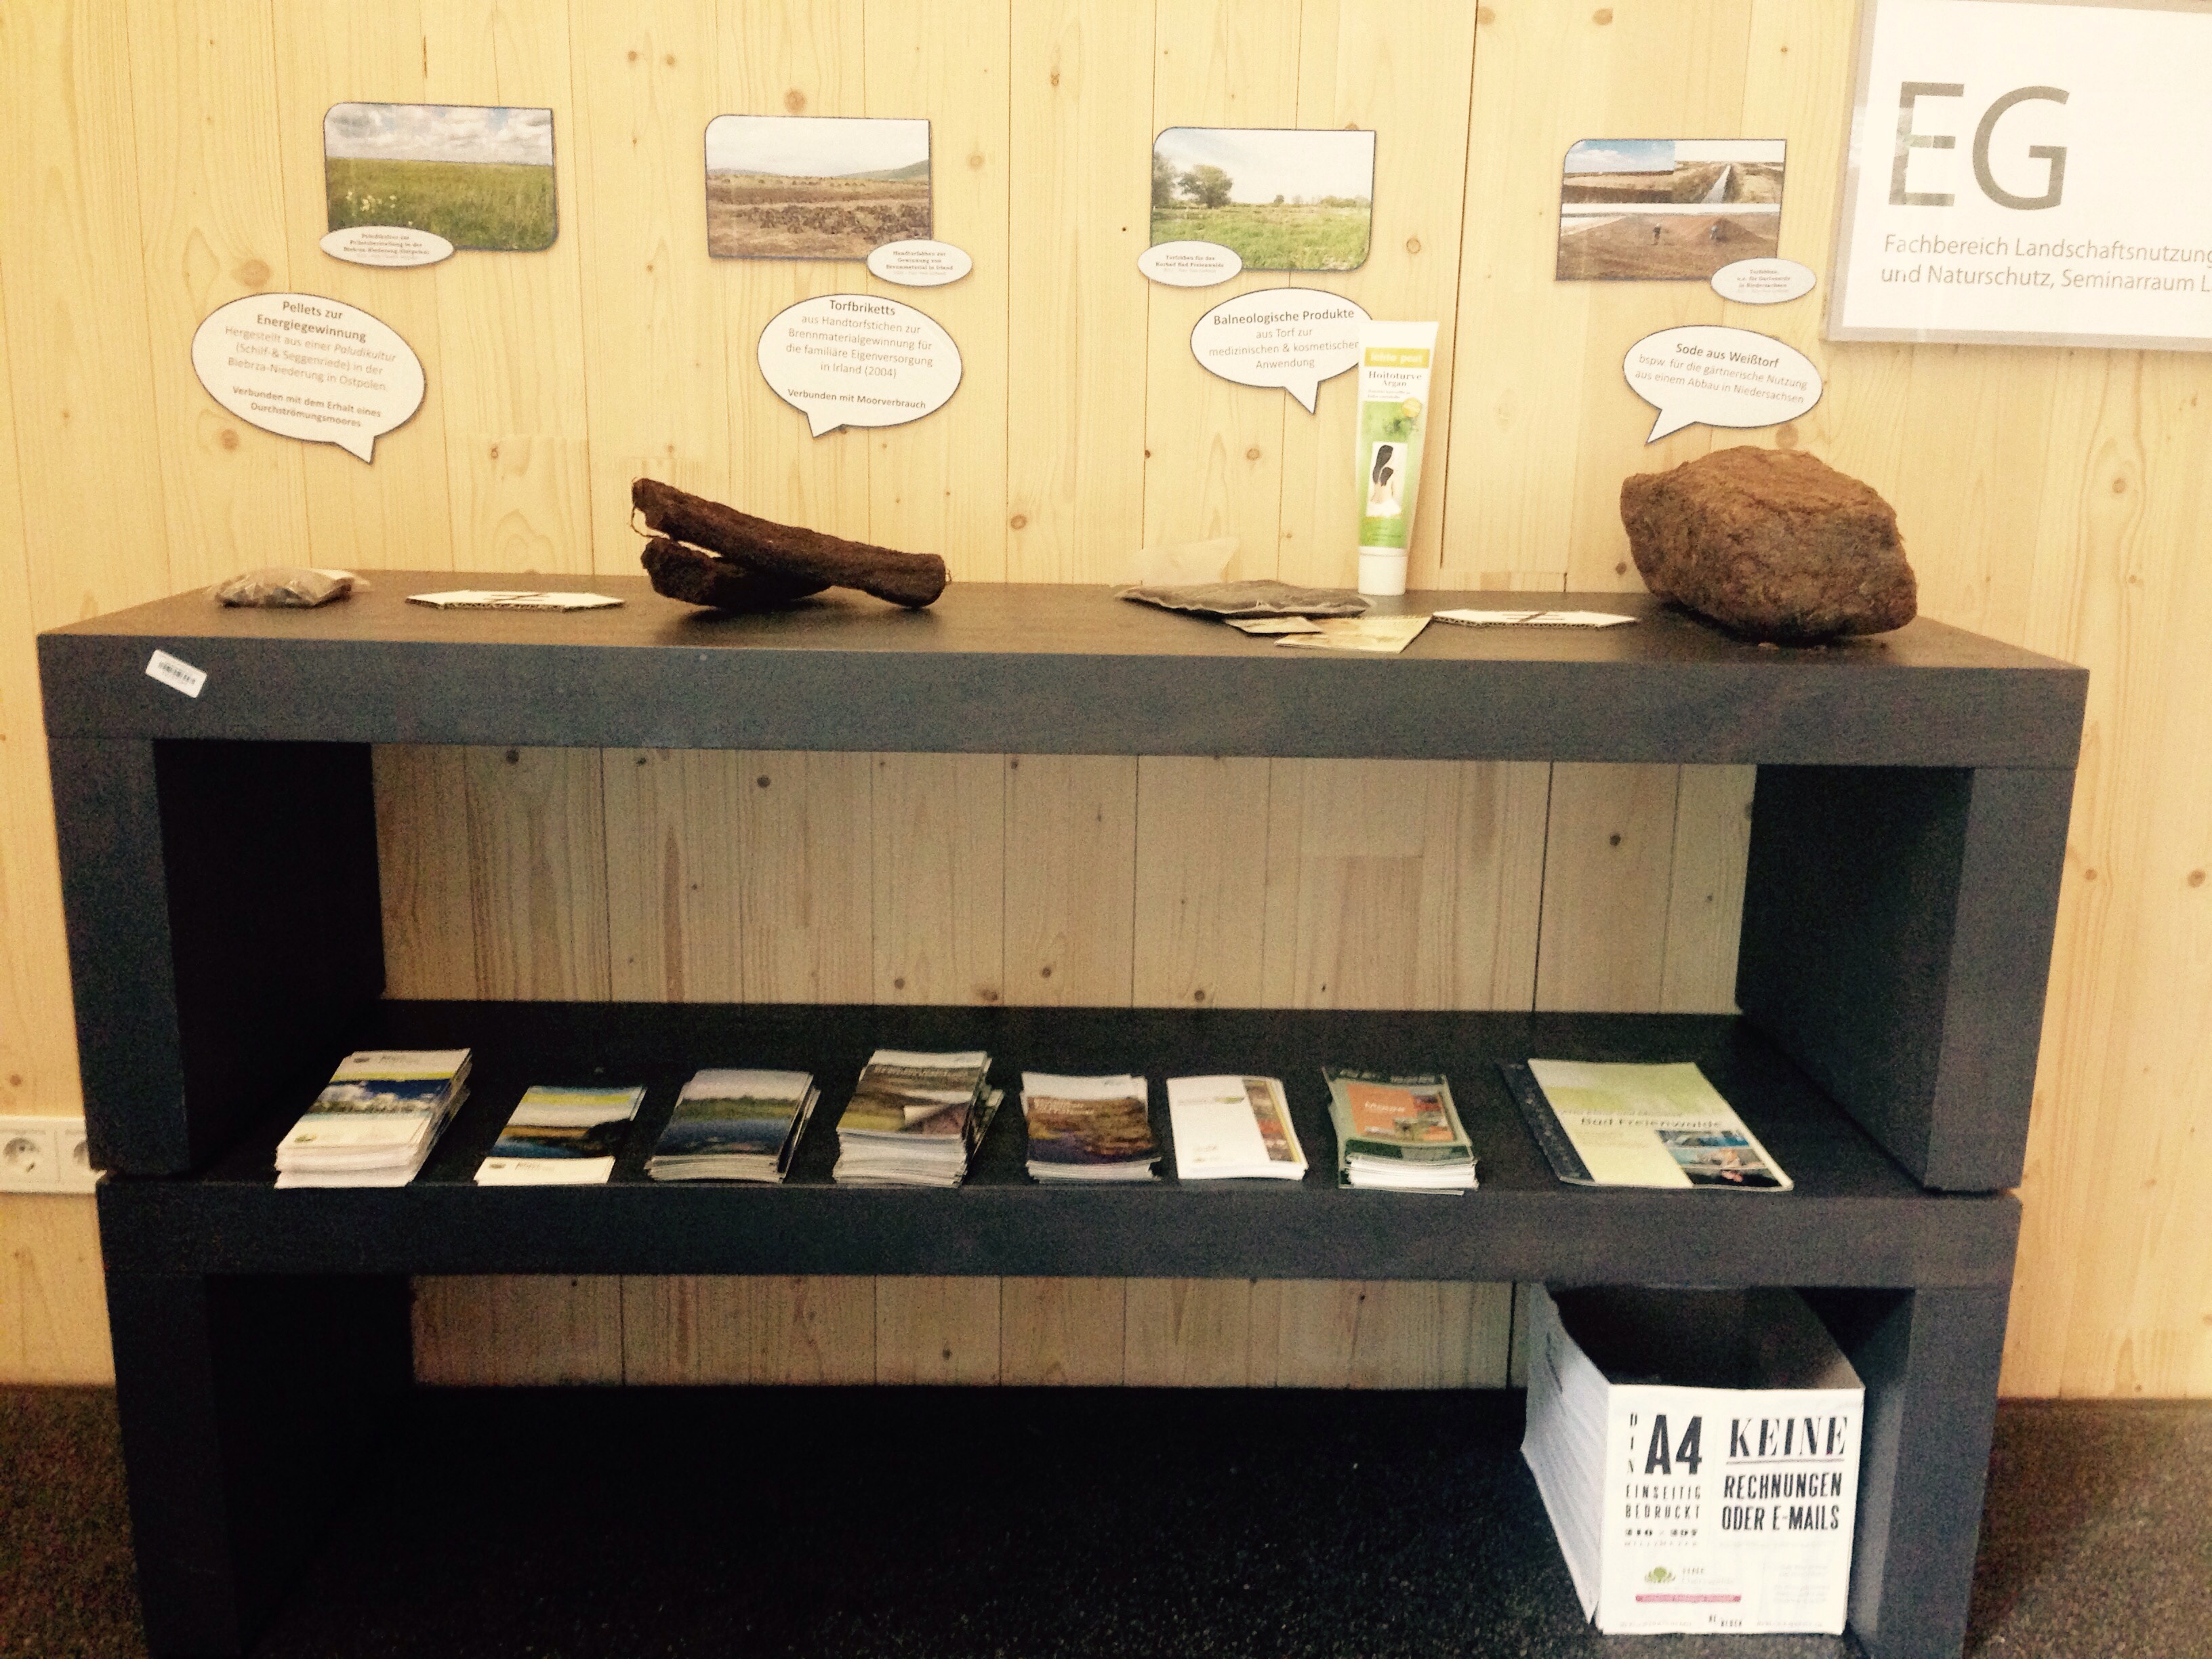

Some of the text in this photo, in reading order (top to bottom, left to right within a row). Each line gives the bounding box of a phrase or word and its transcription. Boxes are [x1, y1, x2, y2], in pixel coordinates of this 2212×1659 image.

[1889, 81, 2070, 210] EG
[1885, 234, 2008, 256] Fachbereich
[1881, 265, 1921, 283] und
[1928, 265, 2055, 289] Naturschutz,
[2062, 270, 2194, 292] Seminarraum
[283, 301, 342, 319] Pellets zur
[830, 300, 895, 316] Torfbriketts
[1214, 308, 1354, 325] Balneologische Produkte
[258, 314, 366, 344] Energiegewinnung
[802, 315, 921, 333] aus Handtorfstichen zur
[1256, 328, 1312, 338] aus Torf zur
[226, 326, 396, 363] Hergestellt aus einer Paludikultur
[789, 328, 932, 350] Brennmaterialgewinnung für
[1209, 344, 1279, 356] medizinischen
[1283, 344, 1289, 352] &
[272, 348, 279, 358] &
[354, 361, 363, 371] in
[367, 363, 383, 375] der
[786, 343, 933, 367] die familiäre Eigenversorgung
[1256, 357, 1315, 369] Anwendung
[1676, 343, 1780, 368] Sode aus Weißtorf
[821, 362, 897, 378] in Irland (2004)
[1369, 371, 1422, 380] Hoitoturve
[1670, 359, 1683, 369] für
[1687, 362, 1701, 372] die
[1704, 366, 1763, 382] gärtnerische
[1767, 371, 1807, 391] Nutzung
[327, 373, 336, 382] in
[339, 375, 386, 391] Ostpolen
[1635, 371, 1651, 380] aus
[1655, 373, 1685, 385] einem
[1687, 377, 1719, 390] Abbau
[1734, 385, 1804, 403] Niedersachsen
[233, 386, 381, 417] Verbunden mit dem Erhalt eines
[788, 389, 926, 409] Verbunden mit Moorverbrauch
[251, 402, 361, 427] Durchströmungsmoores
[1645, 1414, 1703, 1475] A4
[1729, 1416, 1848, 1458] KEINE
[1626, 1485, 1701, 1500] EINSEITIG
[1724, 1473, 1842, 1499] RECHNUNGEN
[1626, 1504, 1701, 1519] BEDRUCKT
[1722, 1505, 1839, 1531] ODER E-MAILS
